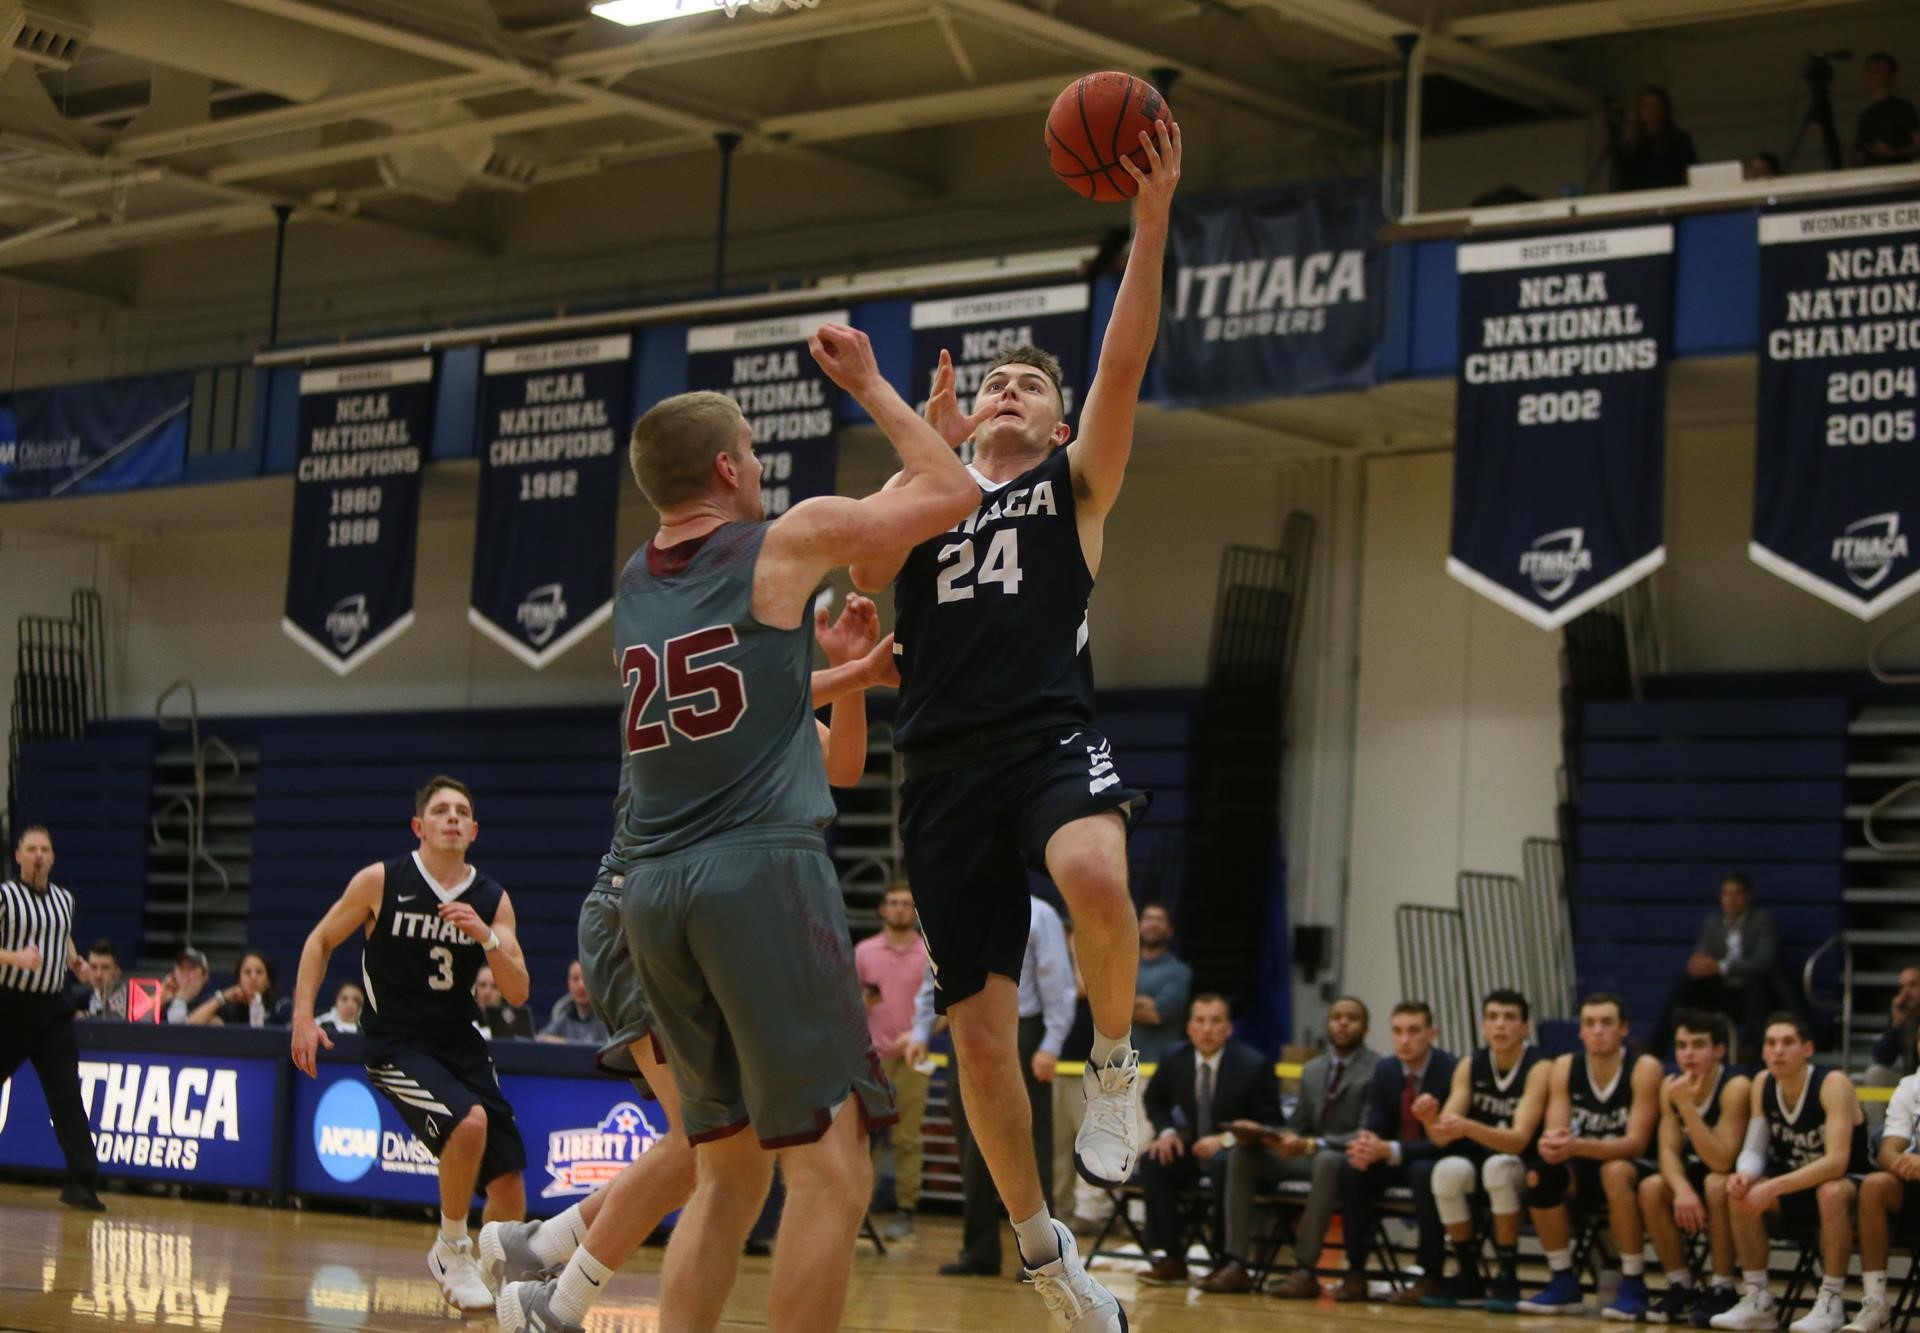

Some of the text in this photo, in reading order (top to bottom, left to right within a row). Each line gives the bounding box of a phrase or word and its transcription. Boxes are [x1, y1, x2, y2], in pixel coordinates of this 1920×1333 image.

[1800, 208, 1889, 233] WOMEN'S
[1826, 244, 1920, 281] NCAA
[1174, 250, 1366, 320] ITHACA
[1518, 271, 1608, 309] NCAA
[1786, 281, 1920, 322] NATION
[1203, 308, 1327, 342] BOMBERS
[1482, 304, 1644, 348] NATIONAL
[1768, 319, 1920, 360] CHAMPIO
[732, 350, 800, 385] NCAA
[1465, 338, 1657, 384] CHAMPIONS
[525, 372, 586, 404] NCAA
[1827, 367, 1917, 404] 2004
[335, 394, 390, 422] NCAA
[499, 400, 608, 436] NATIONAL
[1517, 388, 1602, 426] 2002
[311, 419, 410, 453] NATIONAL
[1826, 409, 1916, 446] 2005
[298, 446, 420, 483] CHAMPIONS
[489, 428, 616, 468] CHAMPIONS
[937, 527, 1024, 605] 24
[620, 623, 749, 756] 25
[427, 946, 454, 991] 3
[77, 1061, 240, 1141] THACA
[90, 1131, 199, 1170] OMBERS
[320, 1125, 378, 1159] NCAA
[552, 1133, 627, 1162] LIBERTY
